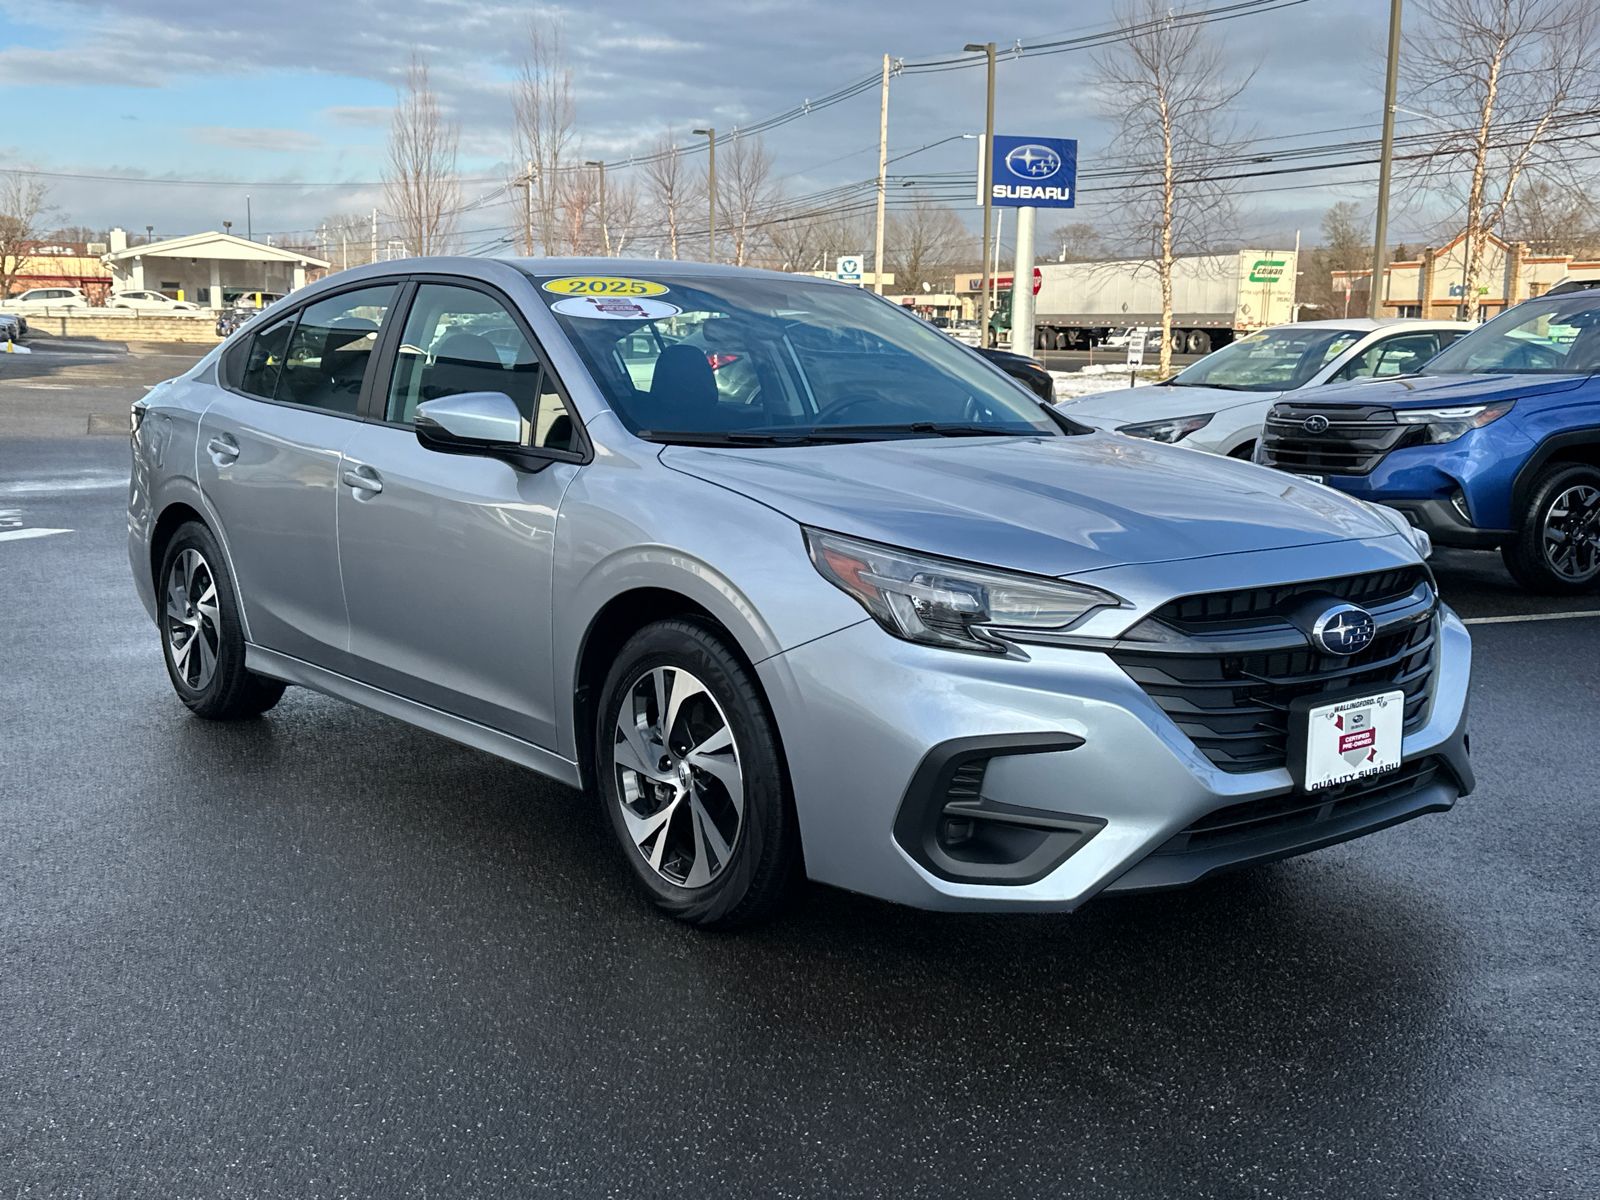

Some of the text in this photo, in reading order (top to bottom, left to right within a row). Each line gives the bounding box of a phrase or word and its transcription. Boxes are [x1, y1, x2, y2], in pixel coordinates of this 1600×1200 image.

[992, 184, 1069, 200] SUBARU
[568, 280, 648, 294] 2025
[1342, 738, 1372, 750] PRE-OWNED
[1345, 732, 1370, 743] CERTIFIED
[1311, 762, 1399, 790] QUALITY SUBARU
